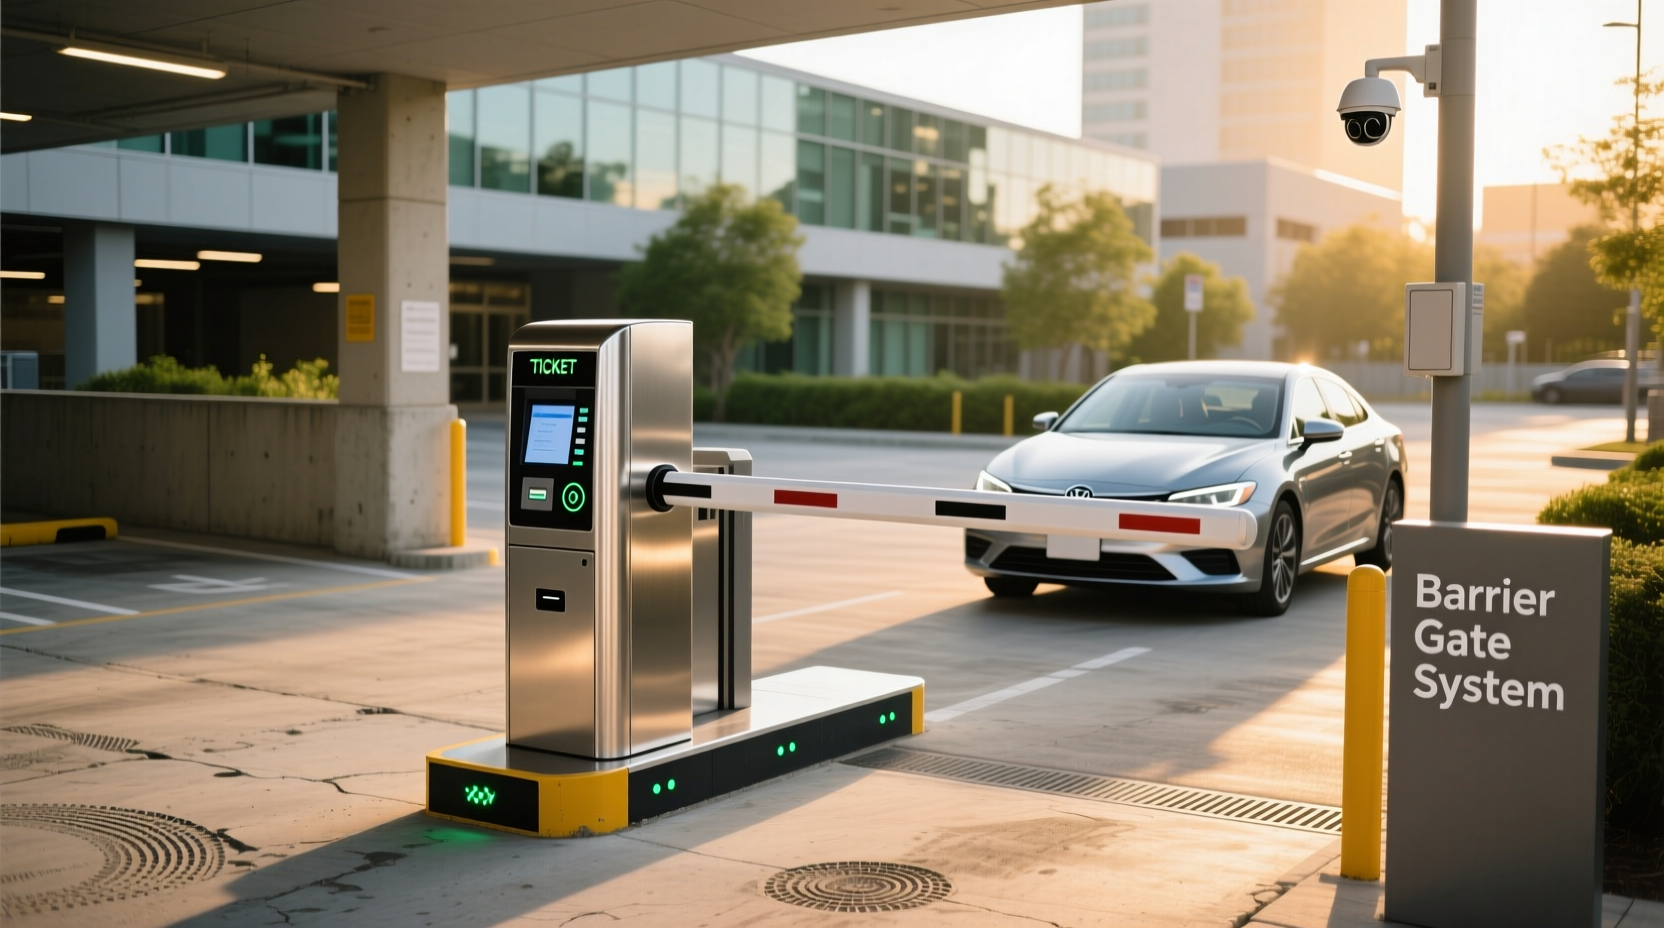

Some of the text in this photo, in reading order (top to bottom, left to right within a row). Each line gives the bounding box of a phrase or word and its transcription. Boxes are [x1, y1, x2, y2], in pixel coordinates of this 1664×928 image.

[530, 358, 577, 375] TICKET
[1416, 573, 1555, 617] Barrier
[1414, 618, 1511, 660] Gate
[1413, 663, 1564, 711] System
